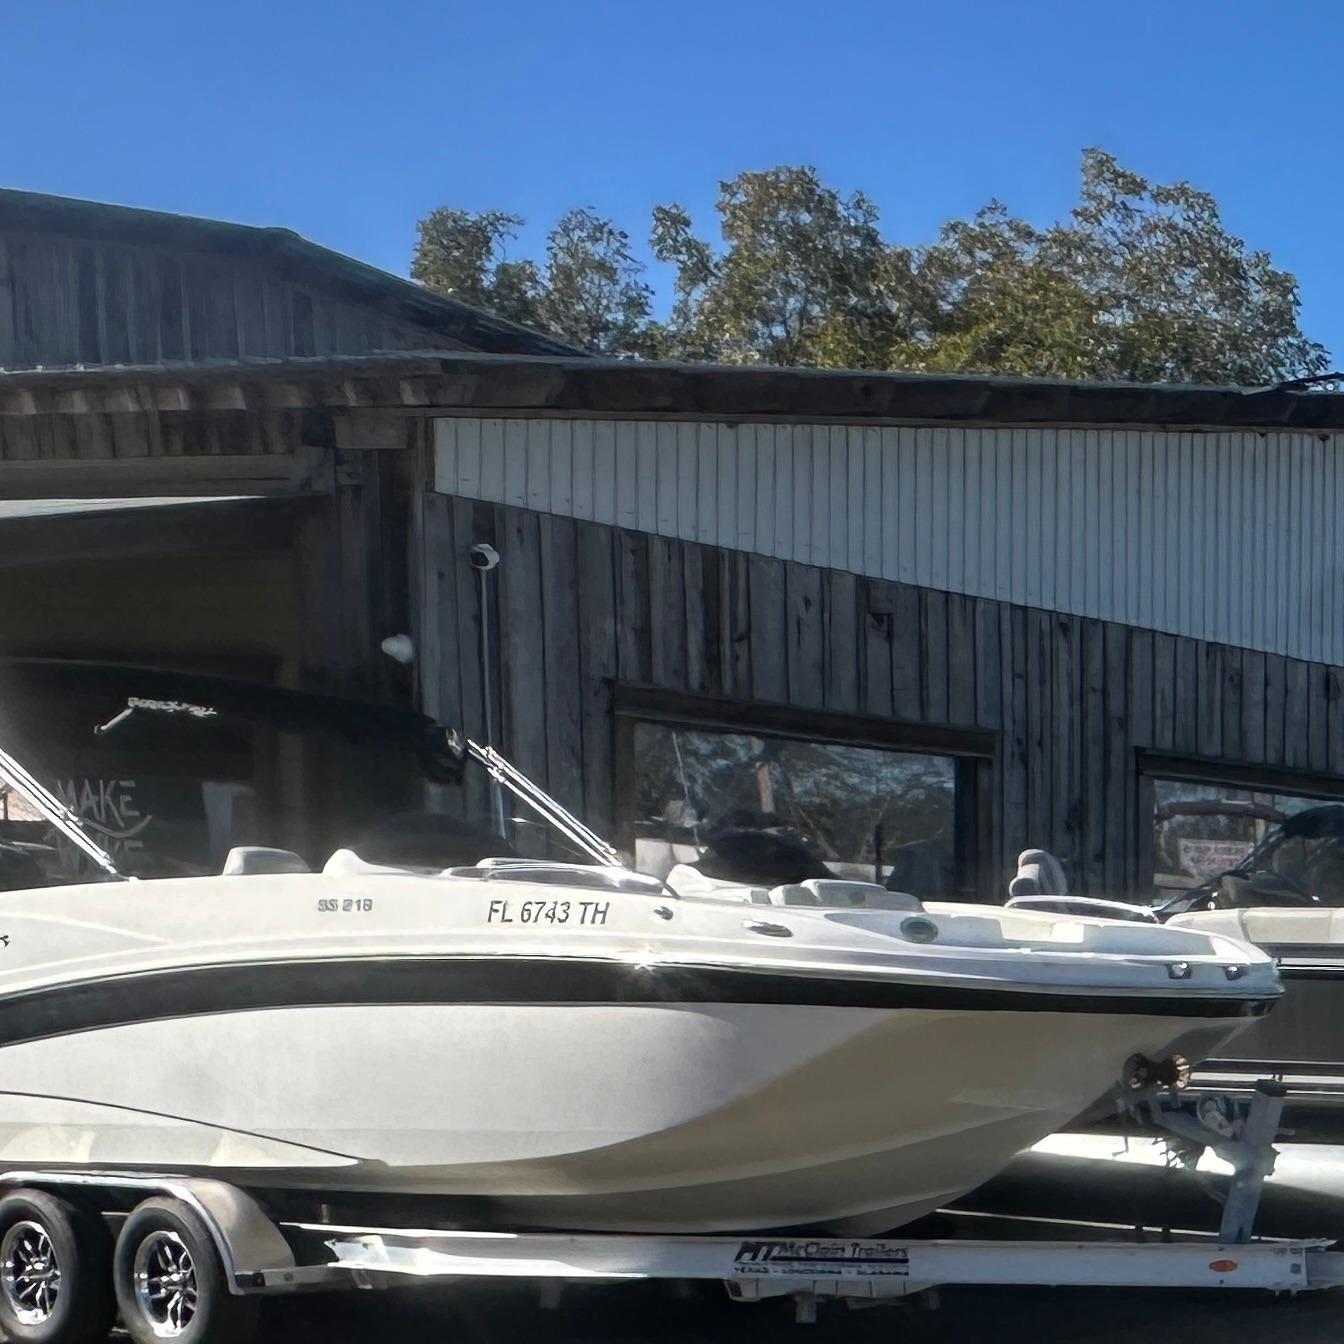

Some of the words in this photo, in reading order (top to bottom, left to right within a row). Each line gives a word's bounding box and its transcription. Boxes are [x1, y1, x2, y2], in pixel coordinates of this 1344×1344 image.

[487, 900, 513, 923] FL
[520, 900, 571, 924] 6743
[579, 901, 611, 925] TH
